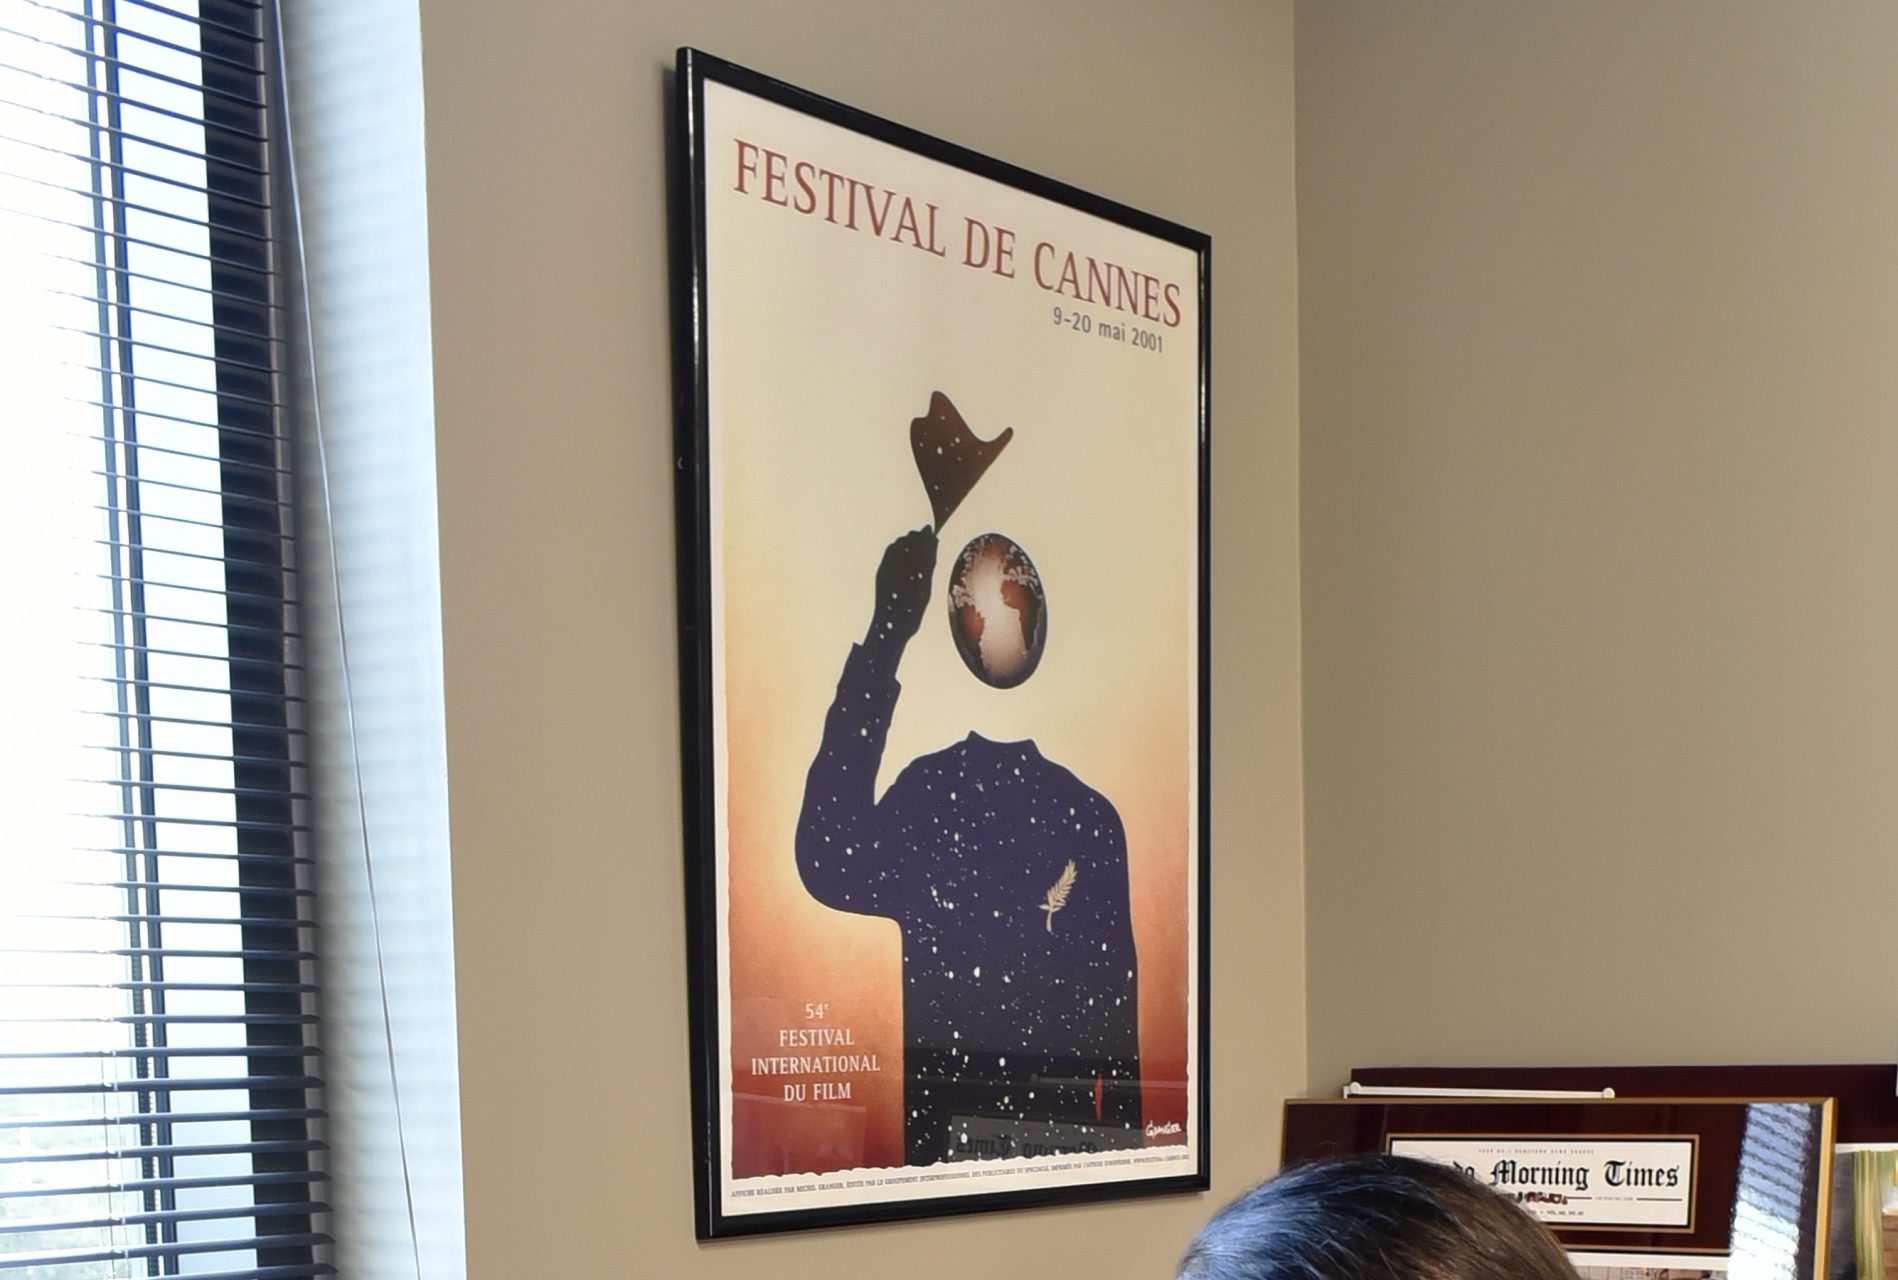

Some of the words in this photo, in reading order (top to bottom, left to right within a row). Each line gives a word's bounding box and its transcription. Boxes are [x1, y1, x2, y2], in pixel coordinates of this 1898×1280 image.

[732, 138, 947, 257] FESTIVAL
[962, 217, 1016, 278] DE
[1034, 242, 1182, 328] CANNES
[1053, 306, 1092, 334] 9-20
[1099, 321, 1126, 343] mai
[1131, 326, 1164, 353] 2001
[779, 1029, 855, 1047] FESTIVAL
[752, 1055, 880, 1075] INTERNATIONAL
[784, 1084, 806, 1101] DU
[814, 1082, 852, 1100] FILM
[1489, 1159, 1590, 1191] Morning
[1604, 1160, 1680, 1187] Times
